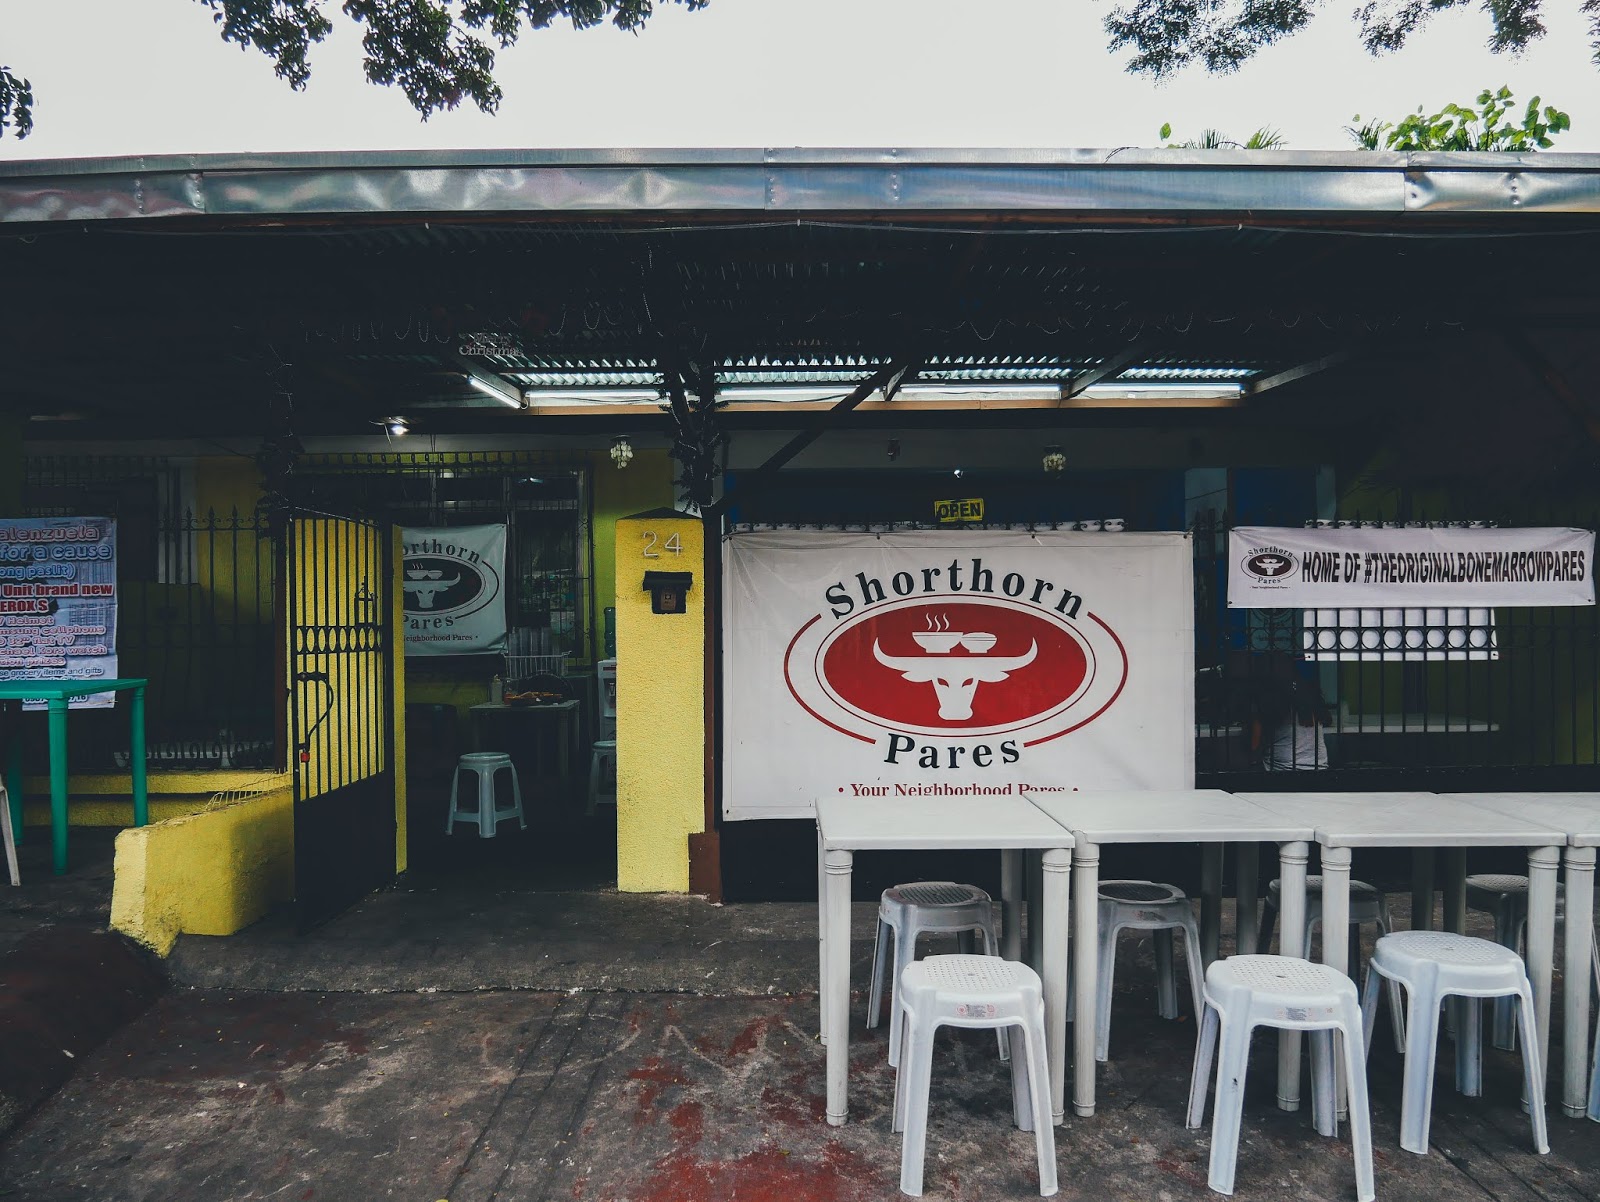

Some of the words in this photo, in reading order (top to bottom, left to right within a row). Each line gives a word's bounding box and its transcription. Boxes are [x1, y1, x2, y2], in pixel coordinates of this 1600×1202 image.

[459, 345, 524, 356] Christmas
[938, 503, 981, 518] OPEN
[643, 531, 683, 557] 24
[0, 545, 28, 559] for
[34, 546, 47, 559] a
[52, 545, 111, 559] cause
[403, 539, 480, 564] orthorn
[1248, 546, 1293, 558] Shorthorn
[28, 564, 74, 579] paslit)
[1302, 552, 1340, 582] HOME
[1344, 552, 1361, 582] OF
[1364, 550, 1585, 583] #THEORIGINALBONEMARROWPARES
[3, 584, 33, 596] Unit
[36, 583, 78, 595] brand
[82, 585, 113, 595] new
[824, 558, 1084, 620] Shorthorn
[8, 616, 54, 624] Helmet
[42, 625, 105, 635] cellphone
[57, 635, 74, 644] TV
[67, 645, 106, 654] watch
[85, 667, 103, 676] gifts
[883, 733, 1020, 769] Pares
[850, 783, 890, 796] Your
